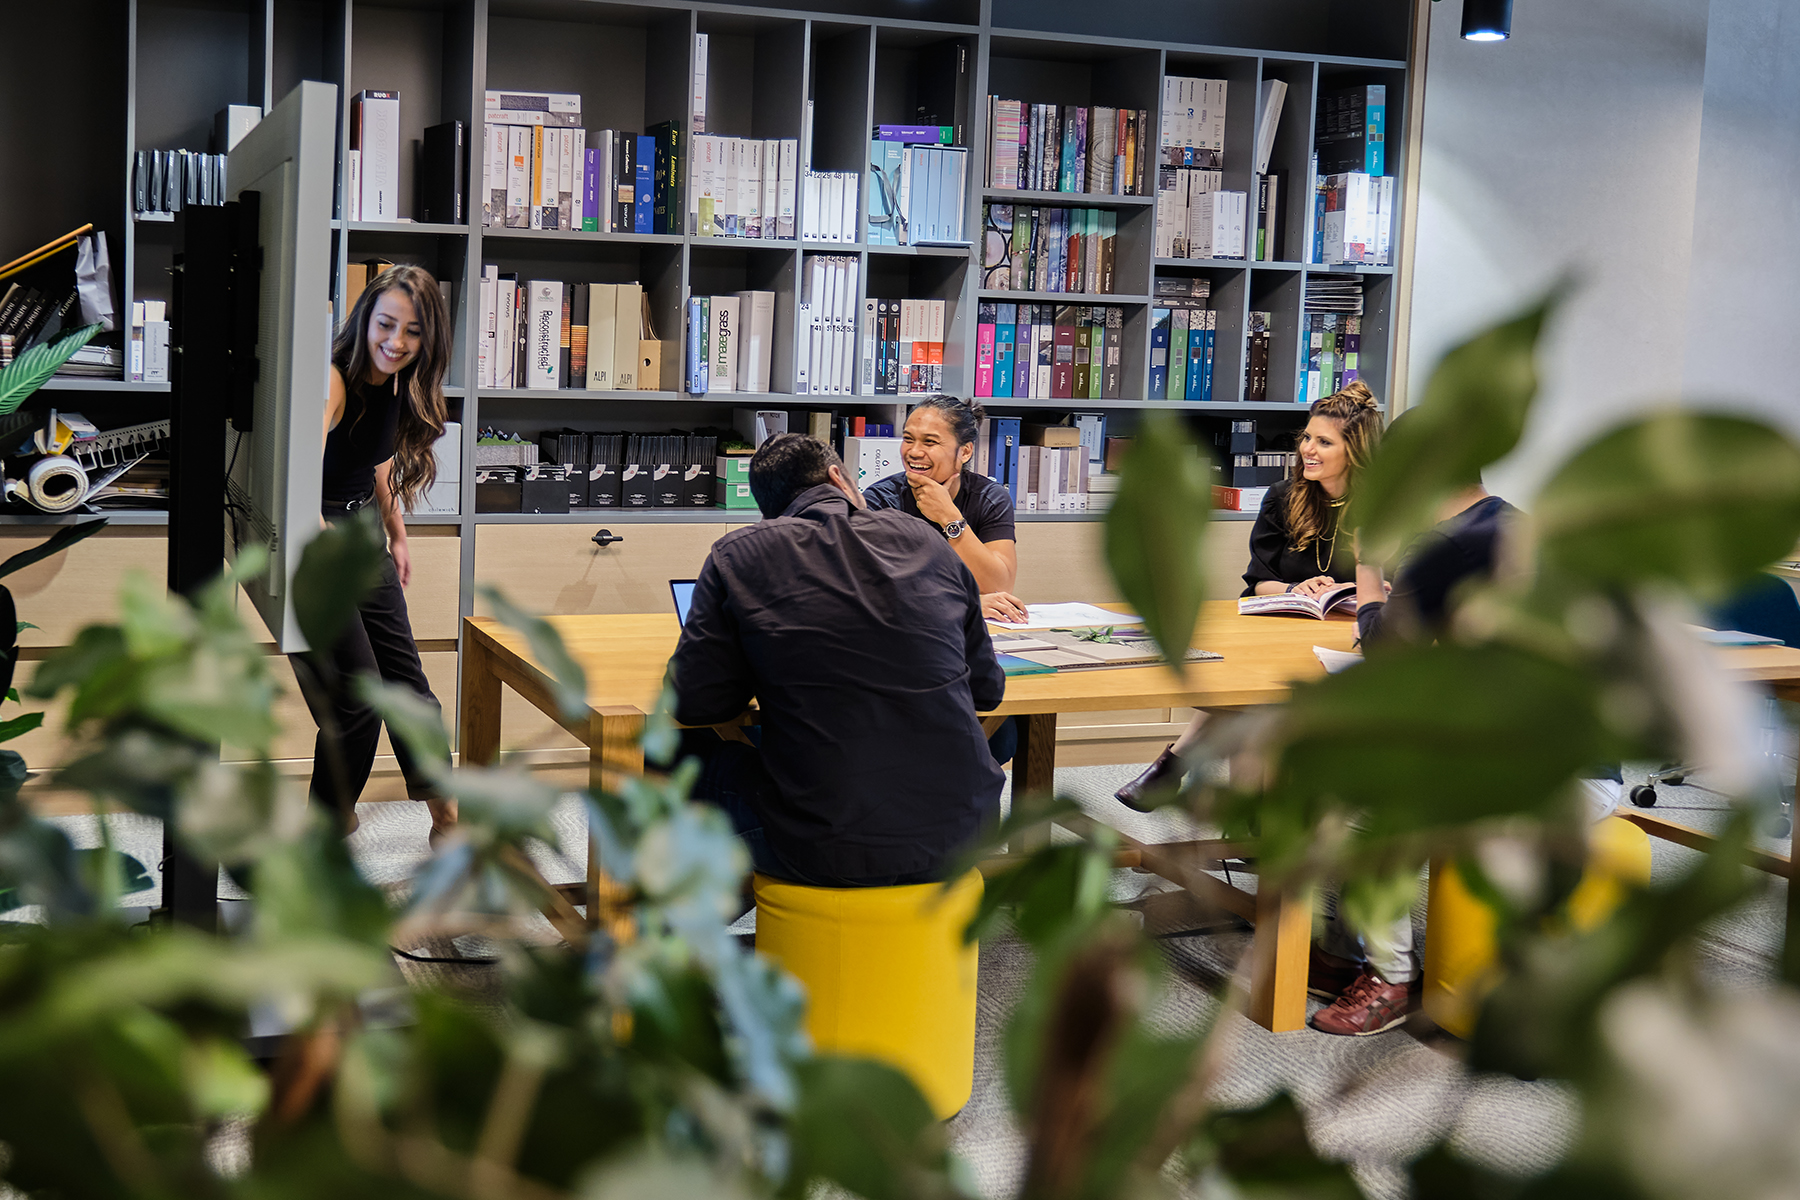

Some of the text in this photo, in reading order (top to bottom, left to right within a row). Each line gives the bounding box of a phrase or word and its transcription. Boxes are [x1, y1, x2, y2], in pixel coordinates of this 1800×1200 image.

[376, 109, 388, 187] VIEW BOOK
[540, 310, 553, 370] Reconstructed
[718, 310, 731, 364] mazegrass
[594, 371, 606, 382] ALPI
[620, 374, 632, 384] ALPI
